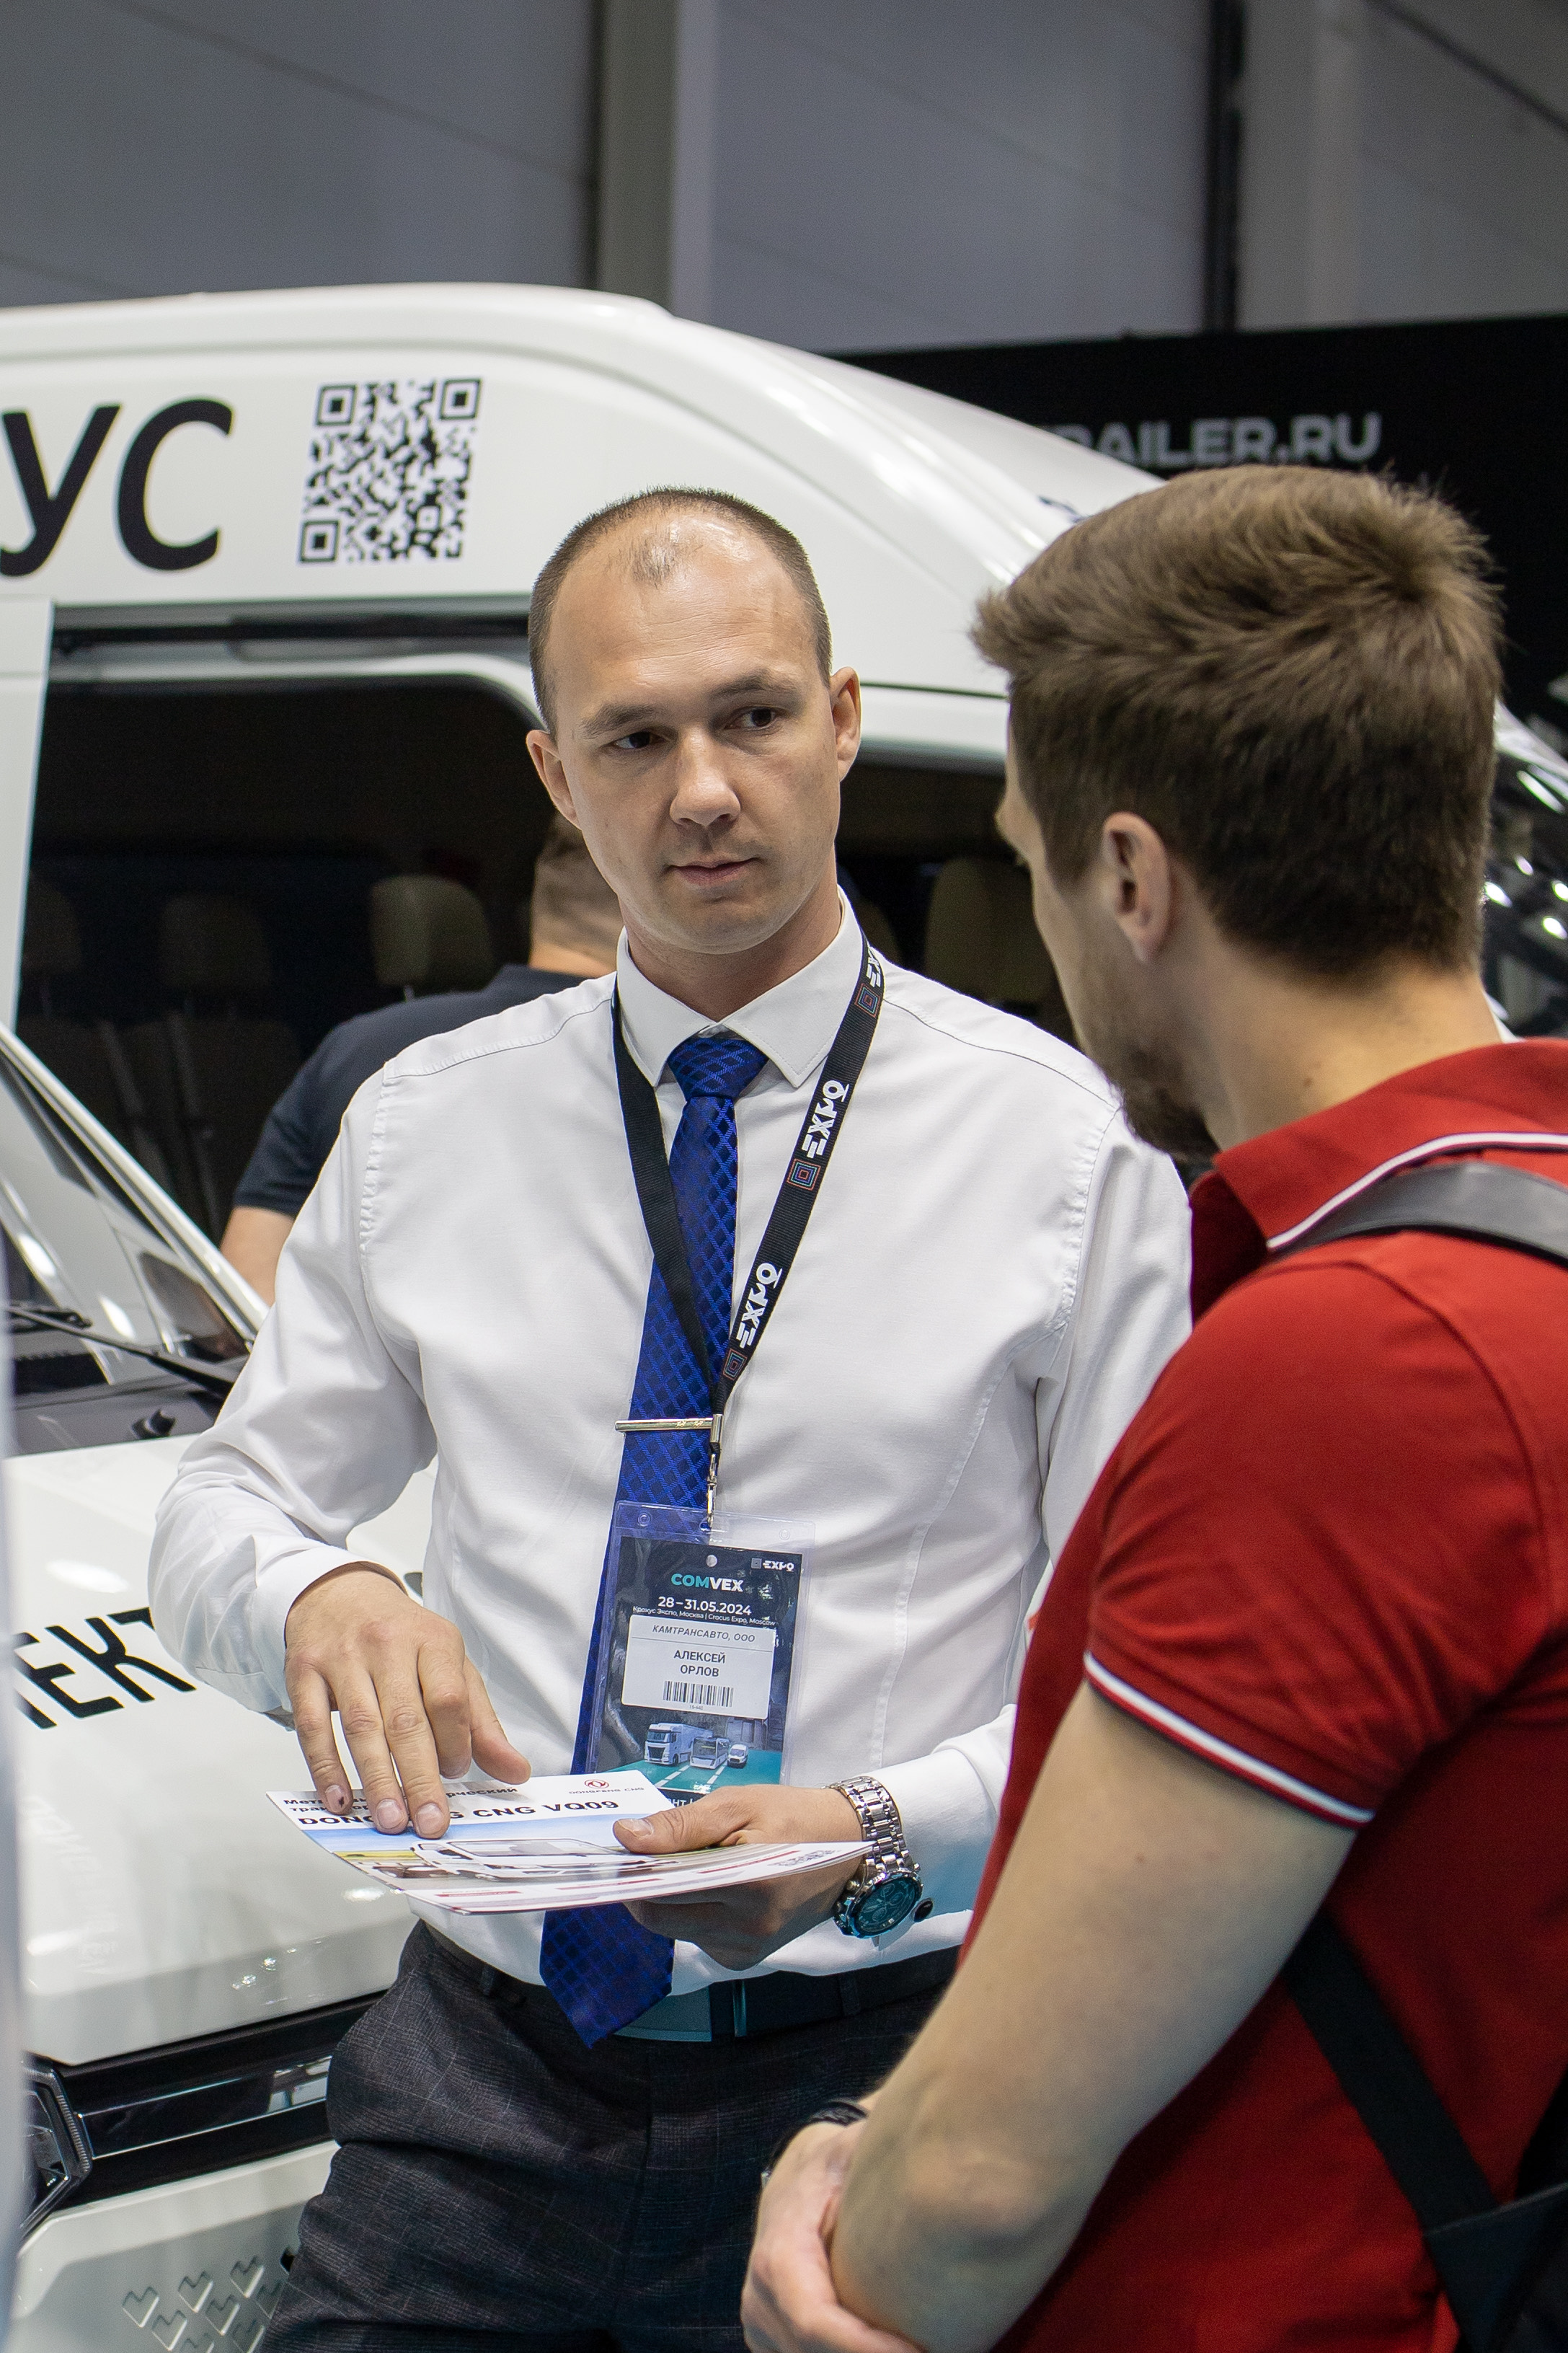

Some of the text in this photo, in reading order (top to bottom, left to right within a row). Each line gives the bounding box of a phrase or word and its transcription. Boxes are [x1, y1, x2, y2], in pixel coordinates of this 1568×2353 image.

[801, 1080, 850, 1158] EXPO
[736, 1262, 783, 1349] EXPO
[763, 1560, 794, 1572] EXPO
[671, 1573, 744, 1592] COMVEX
[708, 1613, 730, 1622] Crocus
[652, 1625, 756, 1643] КАМТРАНСАВТО, ООО
[673, 1650, 726, 1664] АЛЕКСЕЙ
[680, 1664, 719, 1677] ОРЛОВ
[473, 1806, 536, 1818] CNG
[541, 1801, 619, 1811] VQ09
